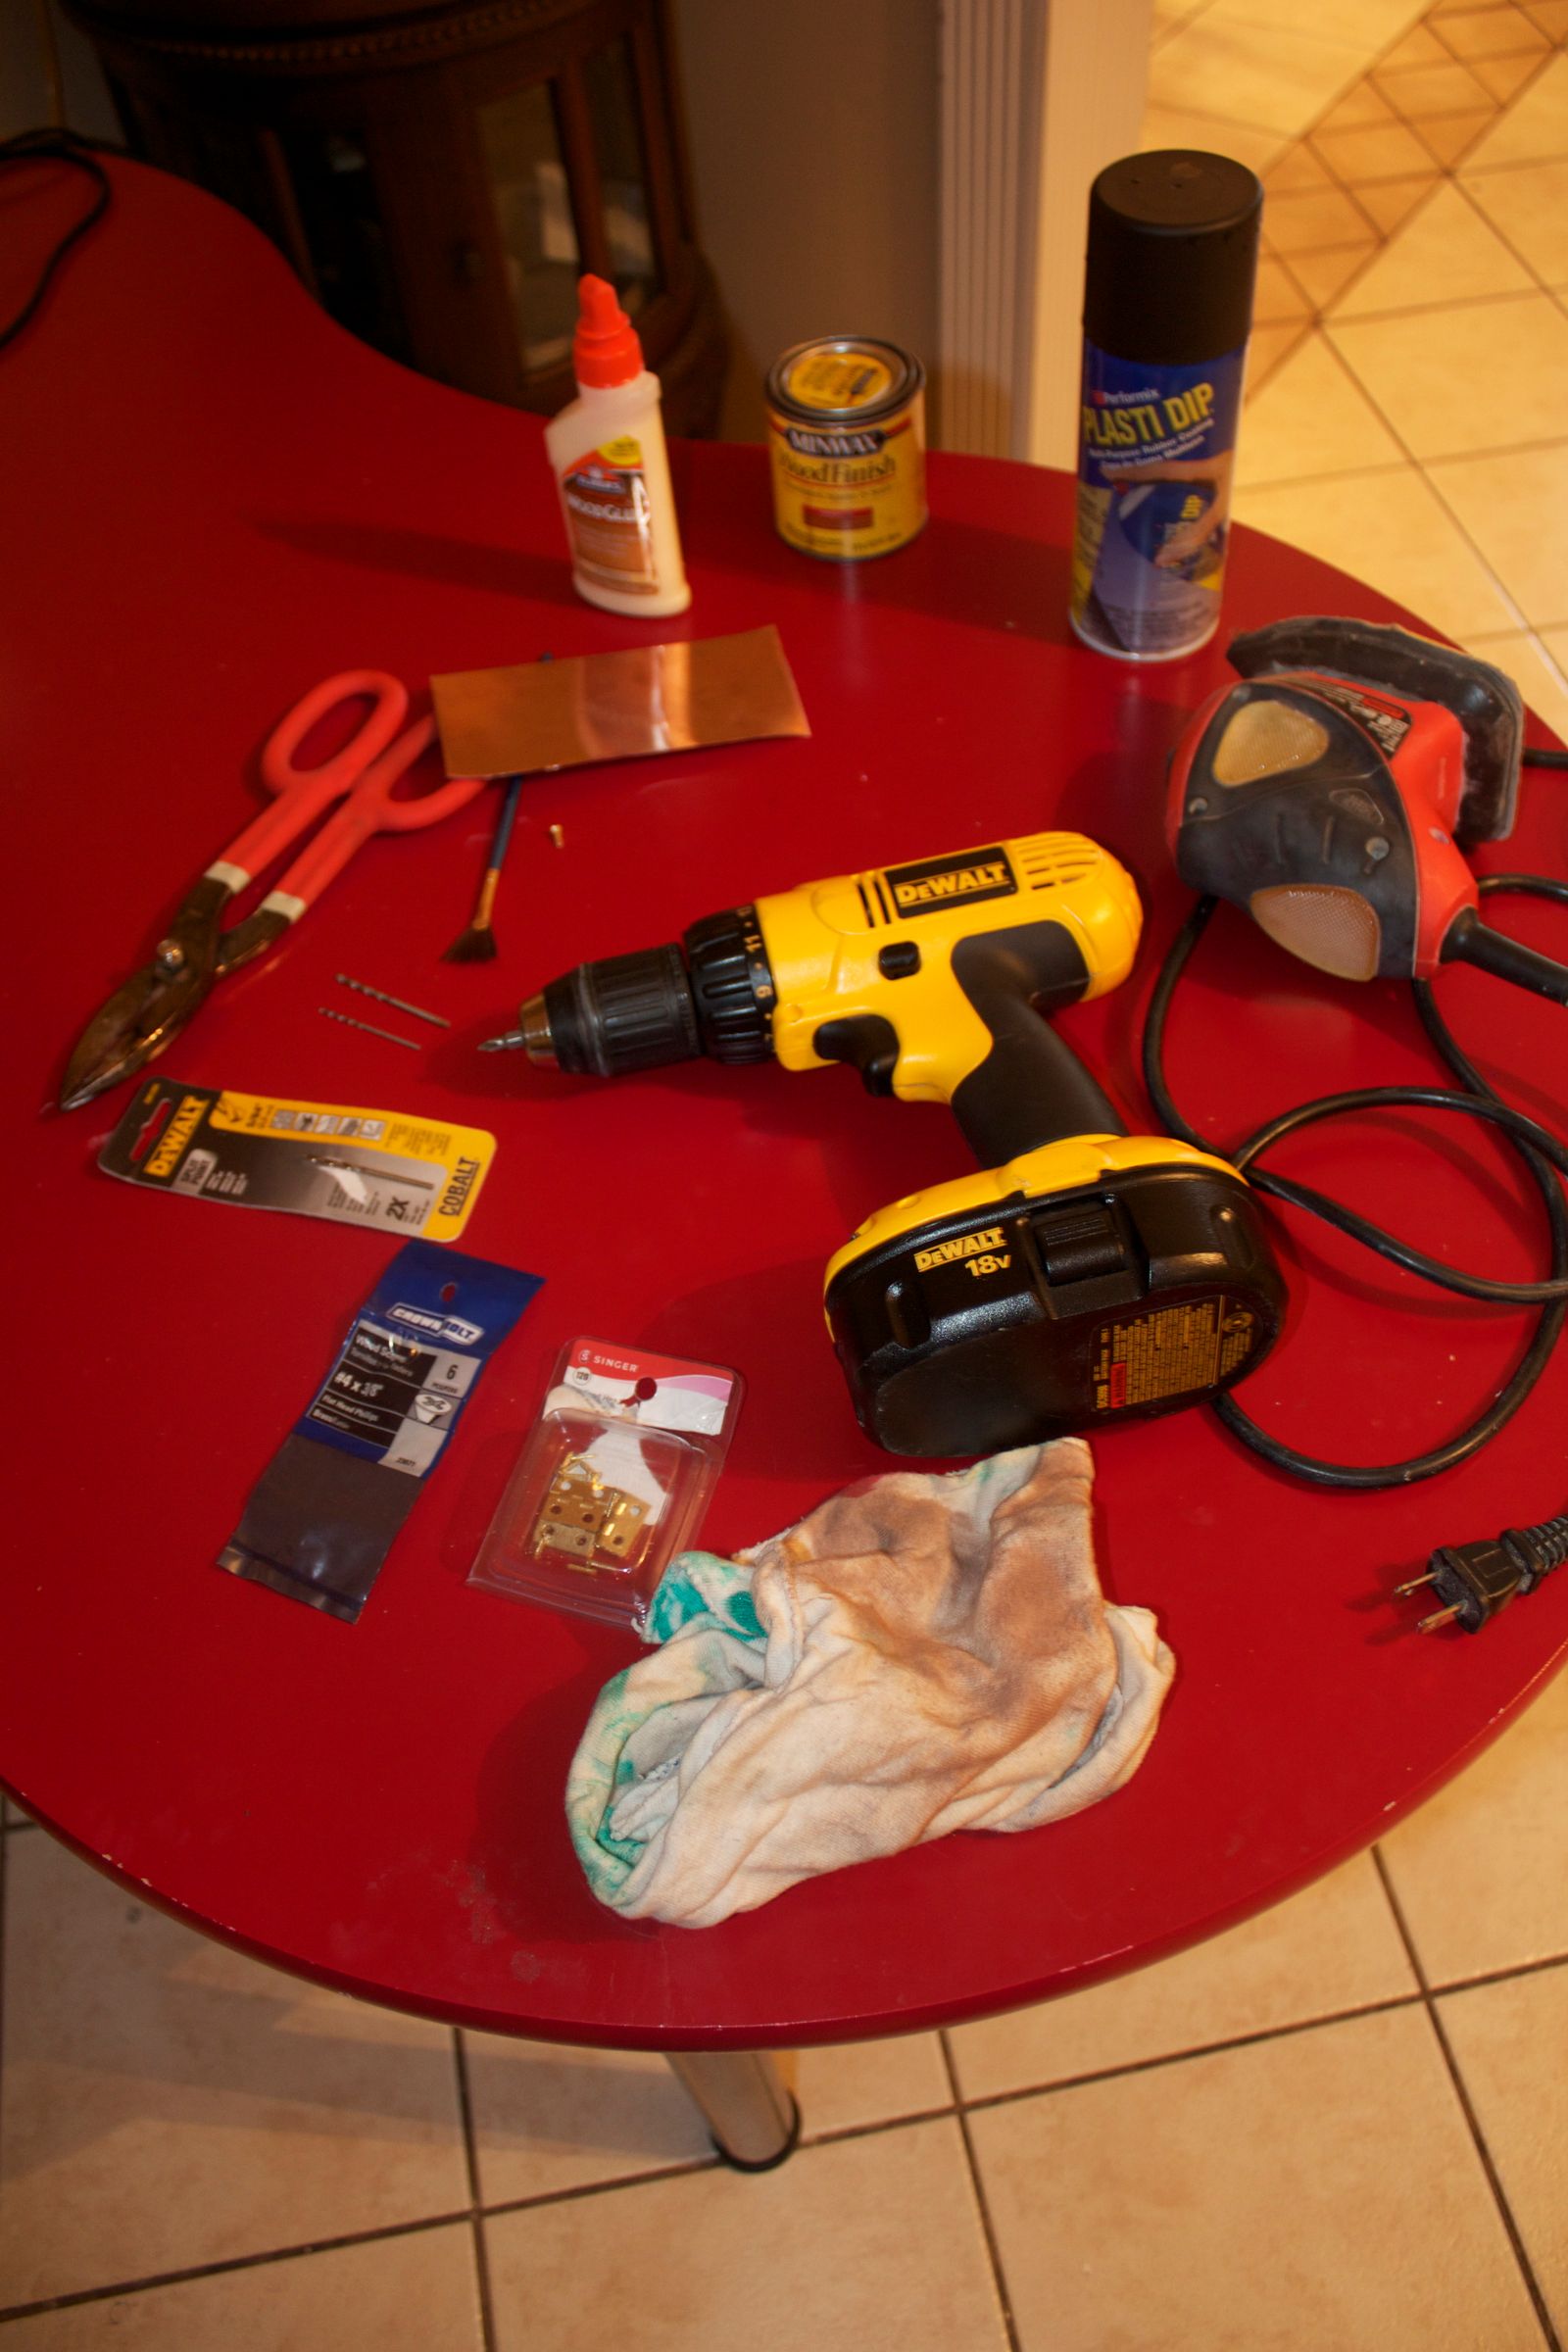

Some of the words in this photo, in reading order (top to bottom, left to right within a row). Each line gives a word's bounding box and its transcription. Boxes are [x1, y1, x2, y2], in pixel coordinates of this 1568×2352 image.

[1082, 404, 1164, 446] PLASTI
[1163, 382, 1214, 432] DIP
[437, 1155, 480, 1218] COBALT
[446, 1364, 459, 1380] 6
[593, 1354, 638, 1373] SINGER
